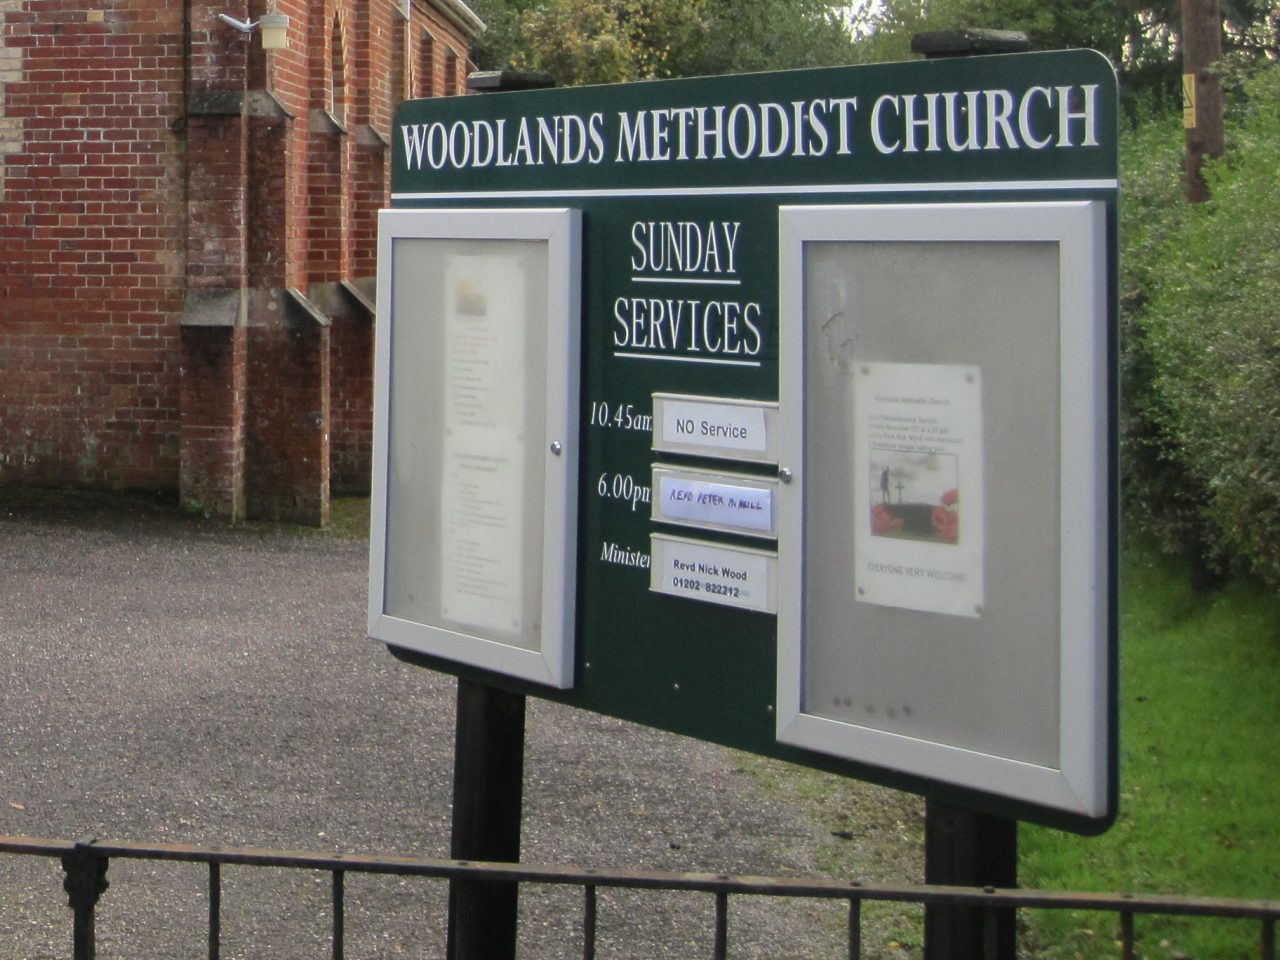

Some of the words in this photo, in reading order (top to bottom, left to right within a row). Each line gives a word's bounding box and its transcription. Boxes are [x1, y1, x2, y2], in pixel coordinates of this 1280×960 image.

[401, 112, 604, 171] WOODLANDS
[615, 96, 858, 162] METHODIST
[870, 84, 1099, 155] CHURCH
[631, 221, 741, 273] SUNDAY
[613, 297, 761, 355] SERVICES
[676, 419, 695, 434] NO
[701, 420, 747, 439] Service
[670, 489, 693, 502] REVD
[697, 492, 724, 506] PETER
[673, 559, 695, 572] Revd
[698, 563, 719, 577] Nick
[721, 568, 747, 581] Wood
[673, 577, 700, 592] 01202
[705, 582, 740, 598] 822212
